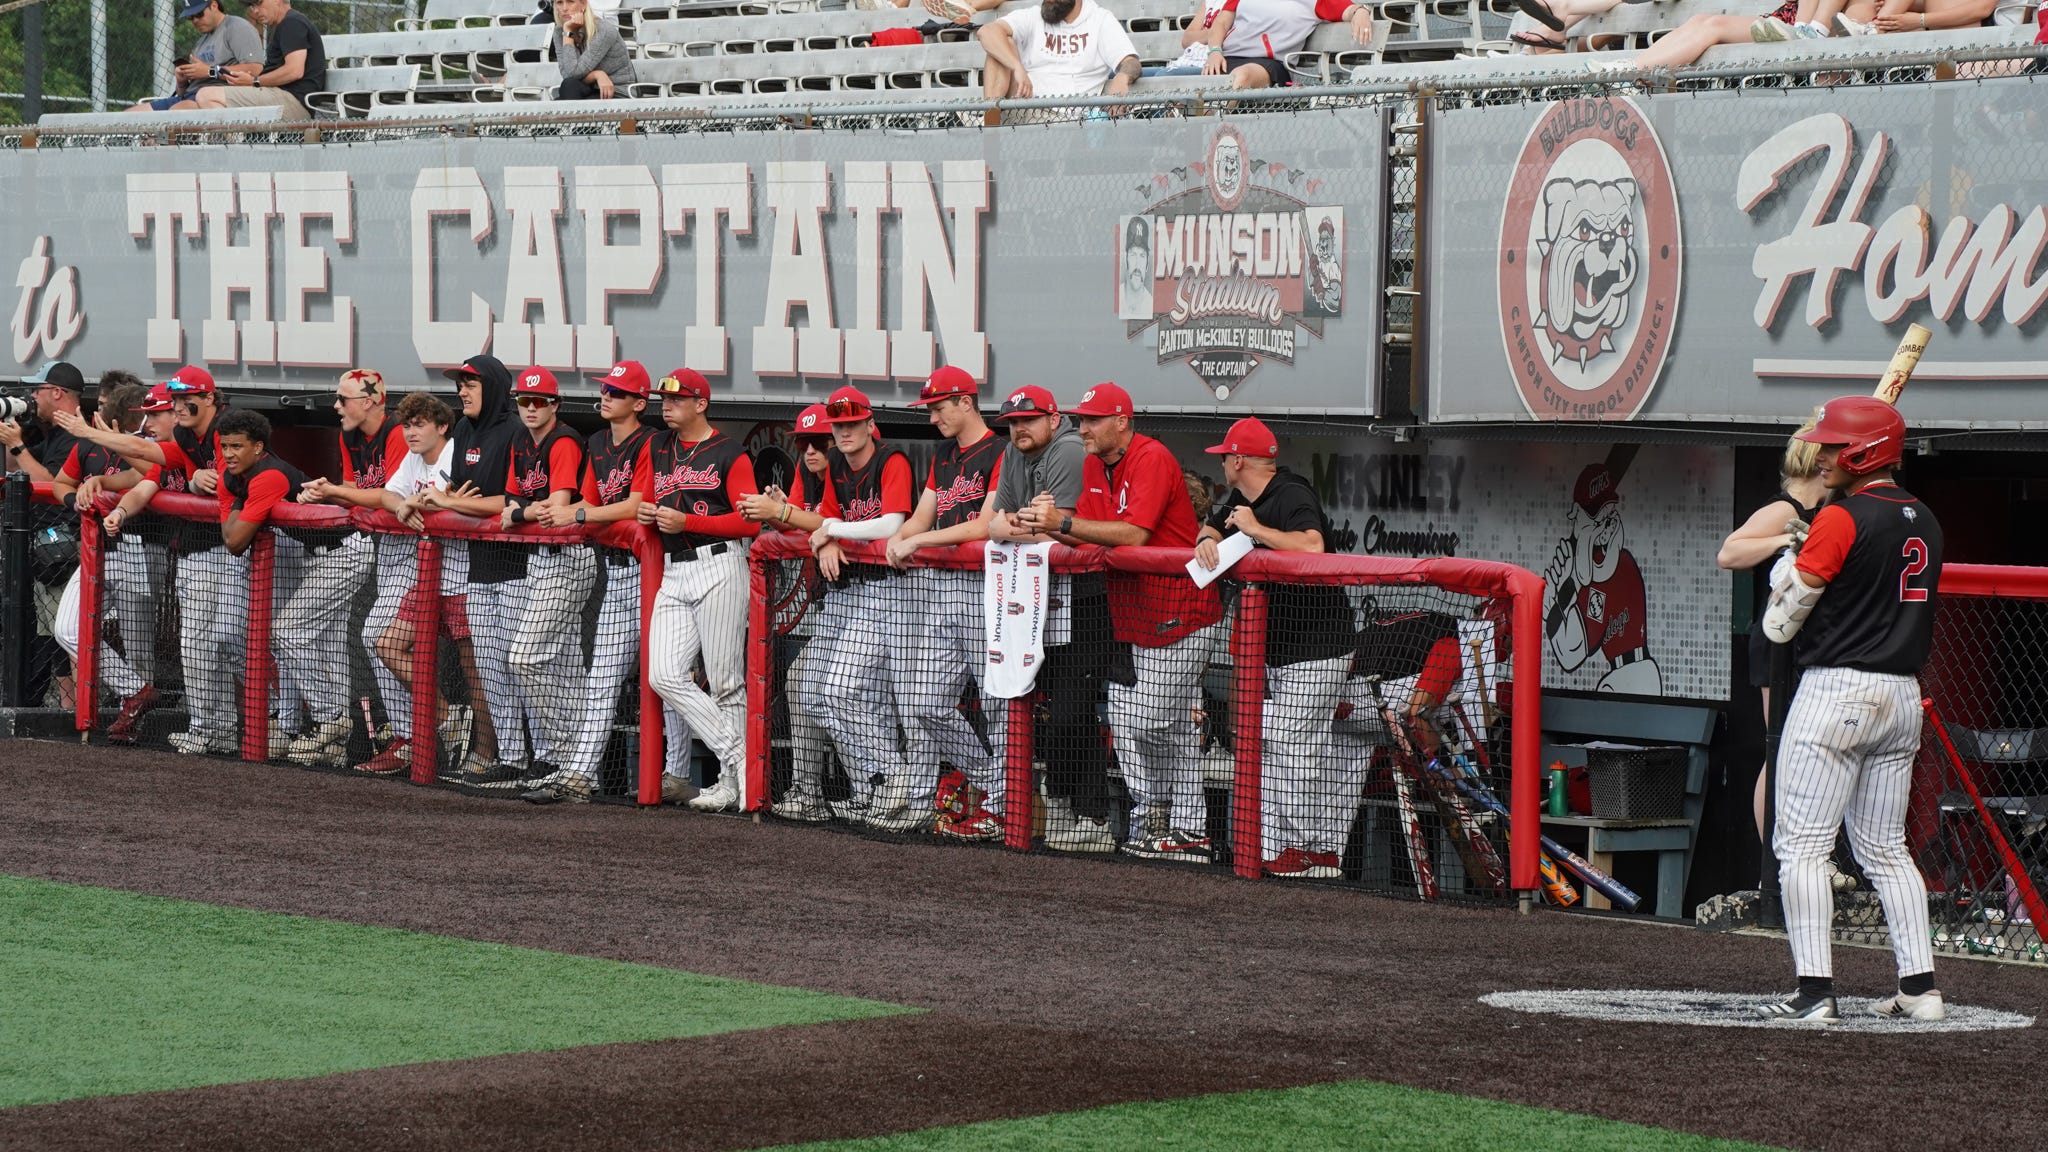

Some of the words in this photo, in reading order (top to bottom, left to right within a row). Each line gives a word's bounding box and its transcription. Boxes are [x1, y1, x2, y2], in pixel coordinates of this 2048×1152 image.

[1045, 32, 1089, 55] WEST
[1539, 100, 1639, 158] BULLDOGS
[10, 236, 87, 364] to
[126, 171, 354, 368] THE
[411, 159, 990, 383] CAPTAIN
[1155, 212, 1302, 278] MUNSON
[1170, 257, 1283, 326] Stadium
[1159, 329, 1194, 355] CANTON
[1247, 328, 1294, 358] BULLDOGS
[1201, 361, 1215, 376] THE
[1216, 361, 1247, 376] CAPTAIN
[1511, 306, 1543, 389] CANTON
[1543, 386, 1569, 415] CITY
[1572, 389, 1624, 419] SCHOOL
[1625, 300, 1664, 393] DISTRICT
[1364, 514, 1460, 558] Champions
[1900, 537, 1928, 602] 2
[994, 573, 1004, 643] BODYARMOR
